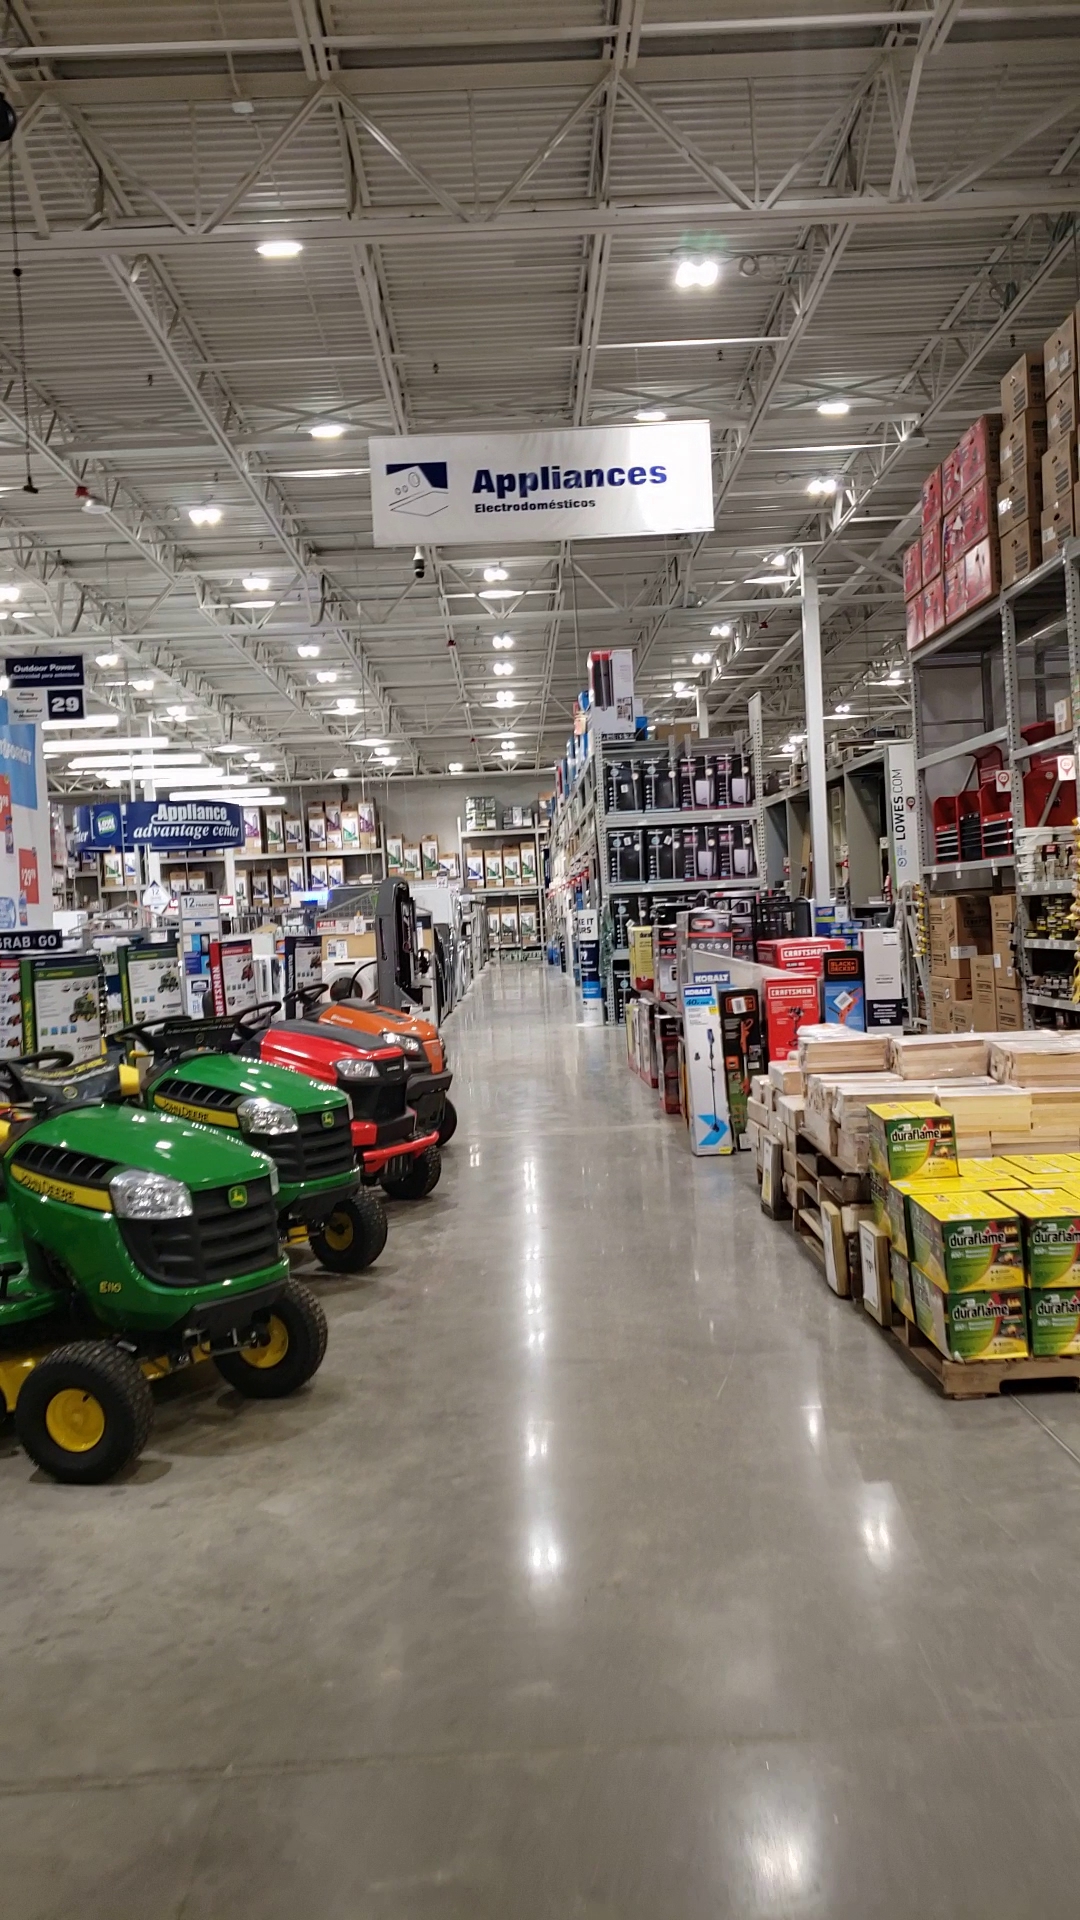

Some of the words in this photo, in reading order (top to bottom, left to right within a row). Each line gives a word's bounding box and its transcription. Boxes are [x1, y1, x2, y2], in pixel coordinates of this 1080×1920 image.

[472, 464, 668, 498] Appliances
[474, 499, 596, 514] Electrodomésticos
[14, 664, 48, 673] Outdoor
[50, 664, 76, 672] Power
[51, 696, 80, 712] 29
[157, 803, 227, 822] Appliance
[133, 824, 209, 840] advantage
[212, 824, 239, 837] center
[184, 897, 195, 909] 12
[38, 934, 56, 948] GO
[694, 974, 728, 982] KOBALT
[212, 966, 225, 1017] RAFTSMAN
[684, 988, 711, 996] KOBALT
[771, 988, 812, 997] CRAFTSMAN
[891, 1128, 940, 1142] duraflame
[950, 1230, 1006, 1247] duraflame
[1034, 1230, 1080, 1243] duraflam
[953, 1304, 1009, 1320] duraflame
[1036, 1300, 1080, 1315] duraflam
